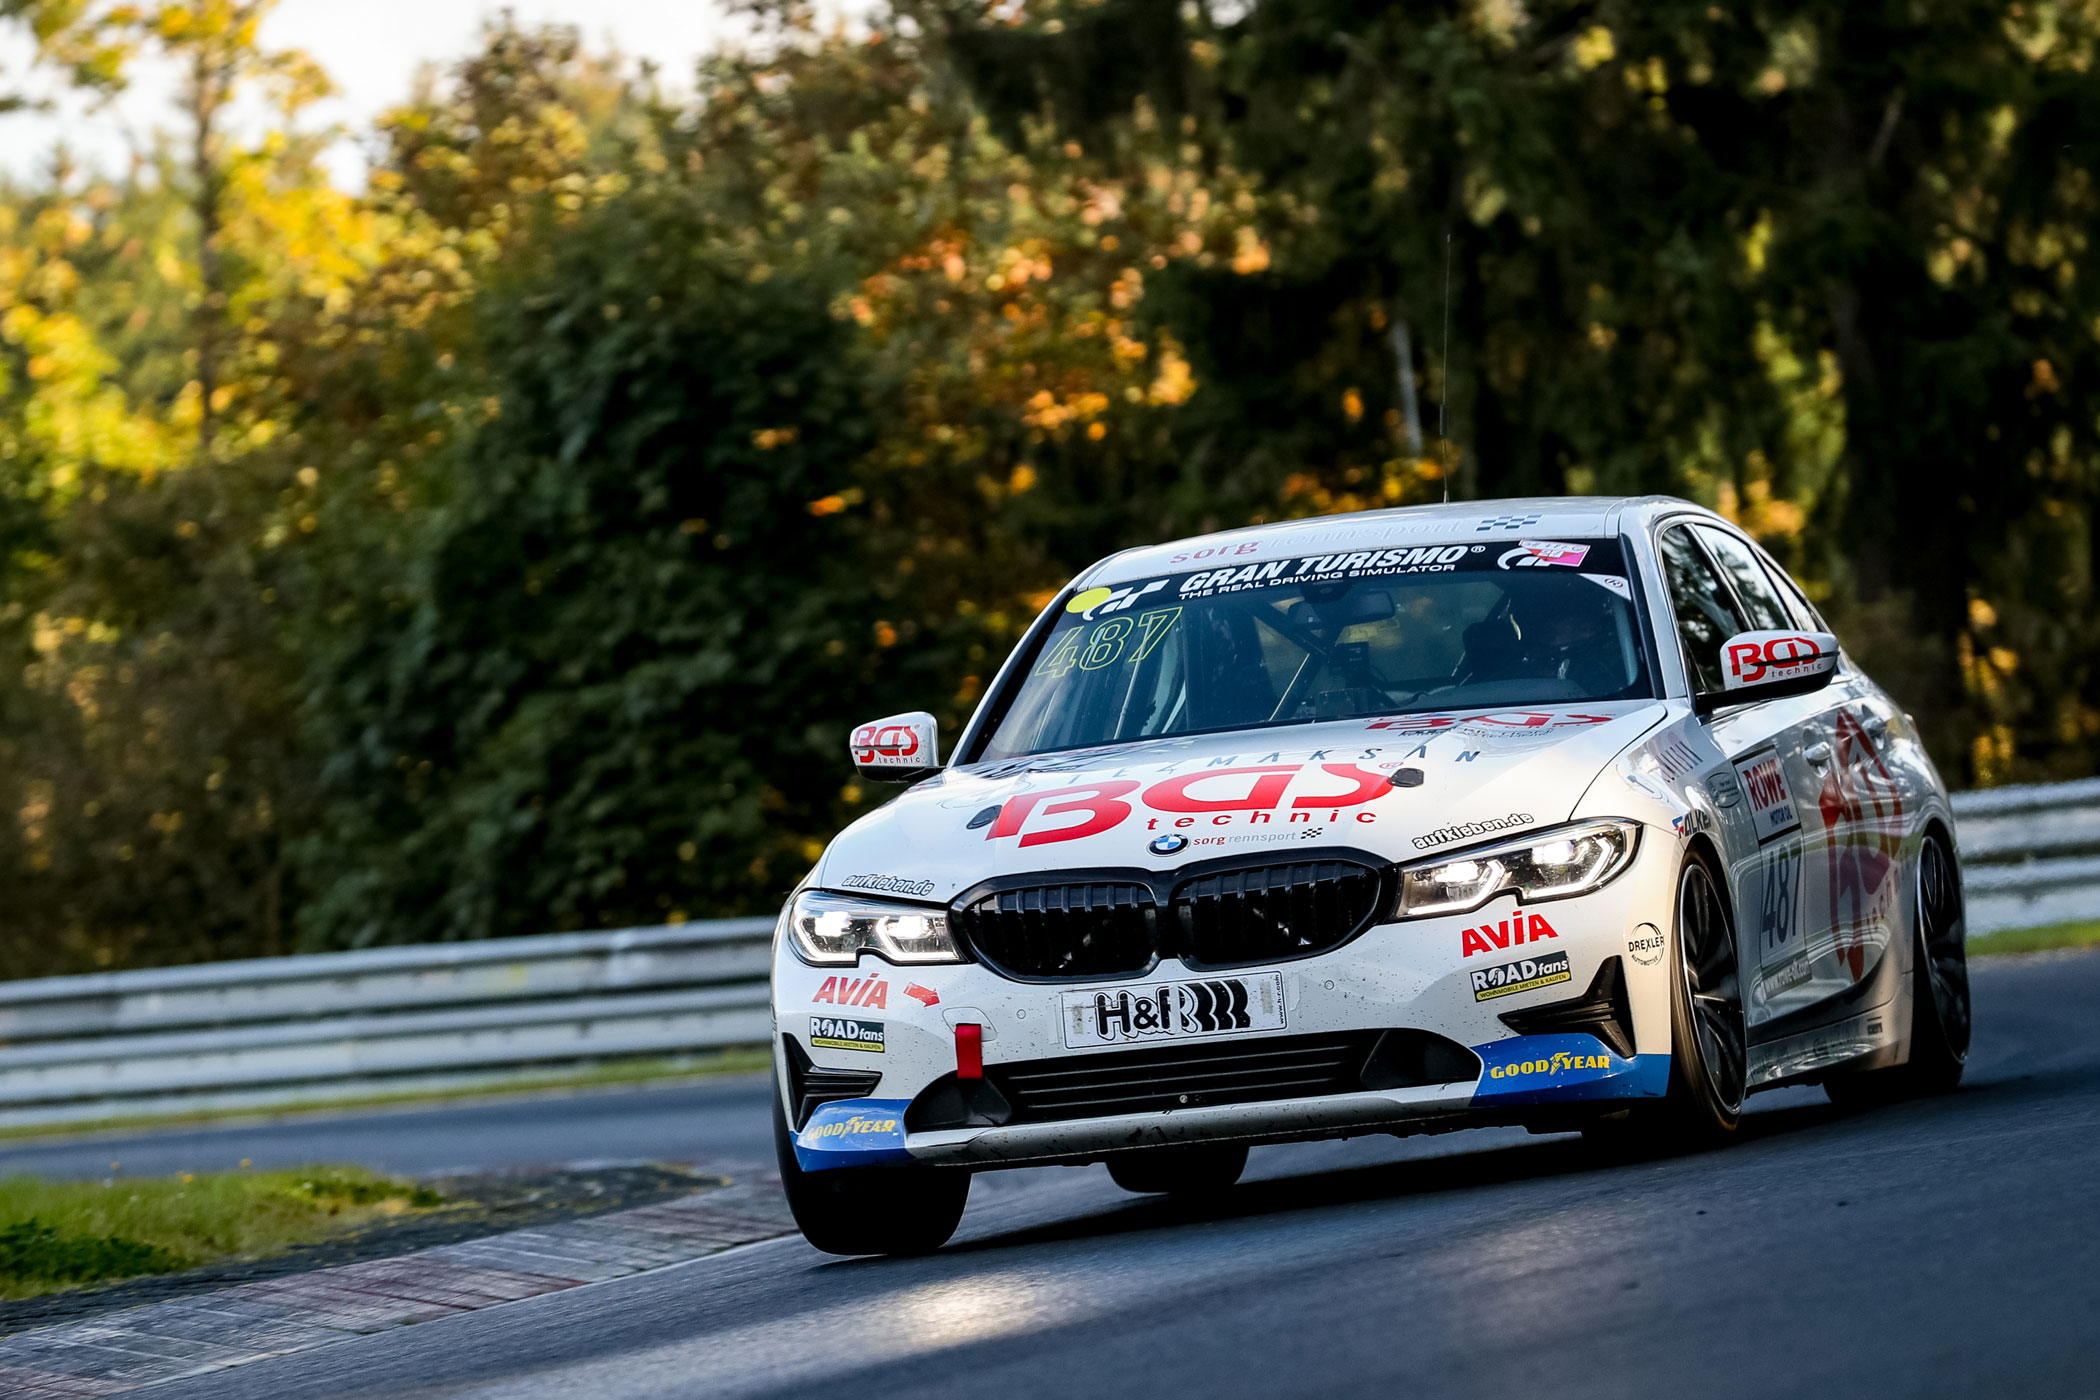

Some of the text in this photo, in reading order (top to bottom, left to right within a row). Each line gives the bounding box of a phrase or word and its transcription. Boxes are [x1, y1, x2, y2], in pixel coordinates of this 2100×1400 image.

[1170, 541, 1262, 564] sorg
[1178, 546, 1469, 594] GRAN TURISMO
[1178, 564, 1455, 600] THE REAL DRIVING SIMULATOR
[1034, 606, 1184, 679] 487
[1771, 662, 1822, 678] technic
[878, 756, 921, 764] technic
[1742, 758, 1787, 812] ROWE
[985, 764, 1394, 848] BGS
[1147, 809, 1377, 830] technic
[1412, 812, 1535, 849] aufkleben.de
[1193, 831, 1296, 846] sorg rennsport
[841, 873, 935, 896] aufkleben.de
[1761, 842, 1801, 950] 487
[1628, 935, 1665, 953] DREXLER
[1480, 984, 1518, 998] WOHNMOBILE
[1519, 979, 1540, 990] MIETEN
[1545, 974, 1567, 984] KAUFEN
[1490, 1051, 1610, 1079] GOODYEAR
